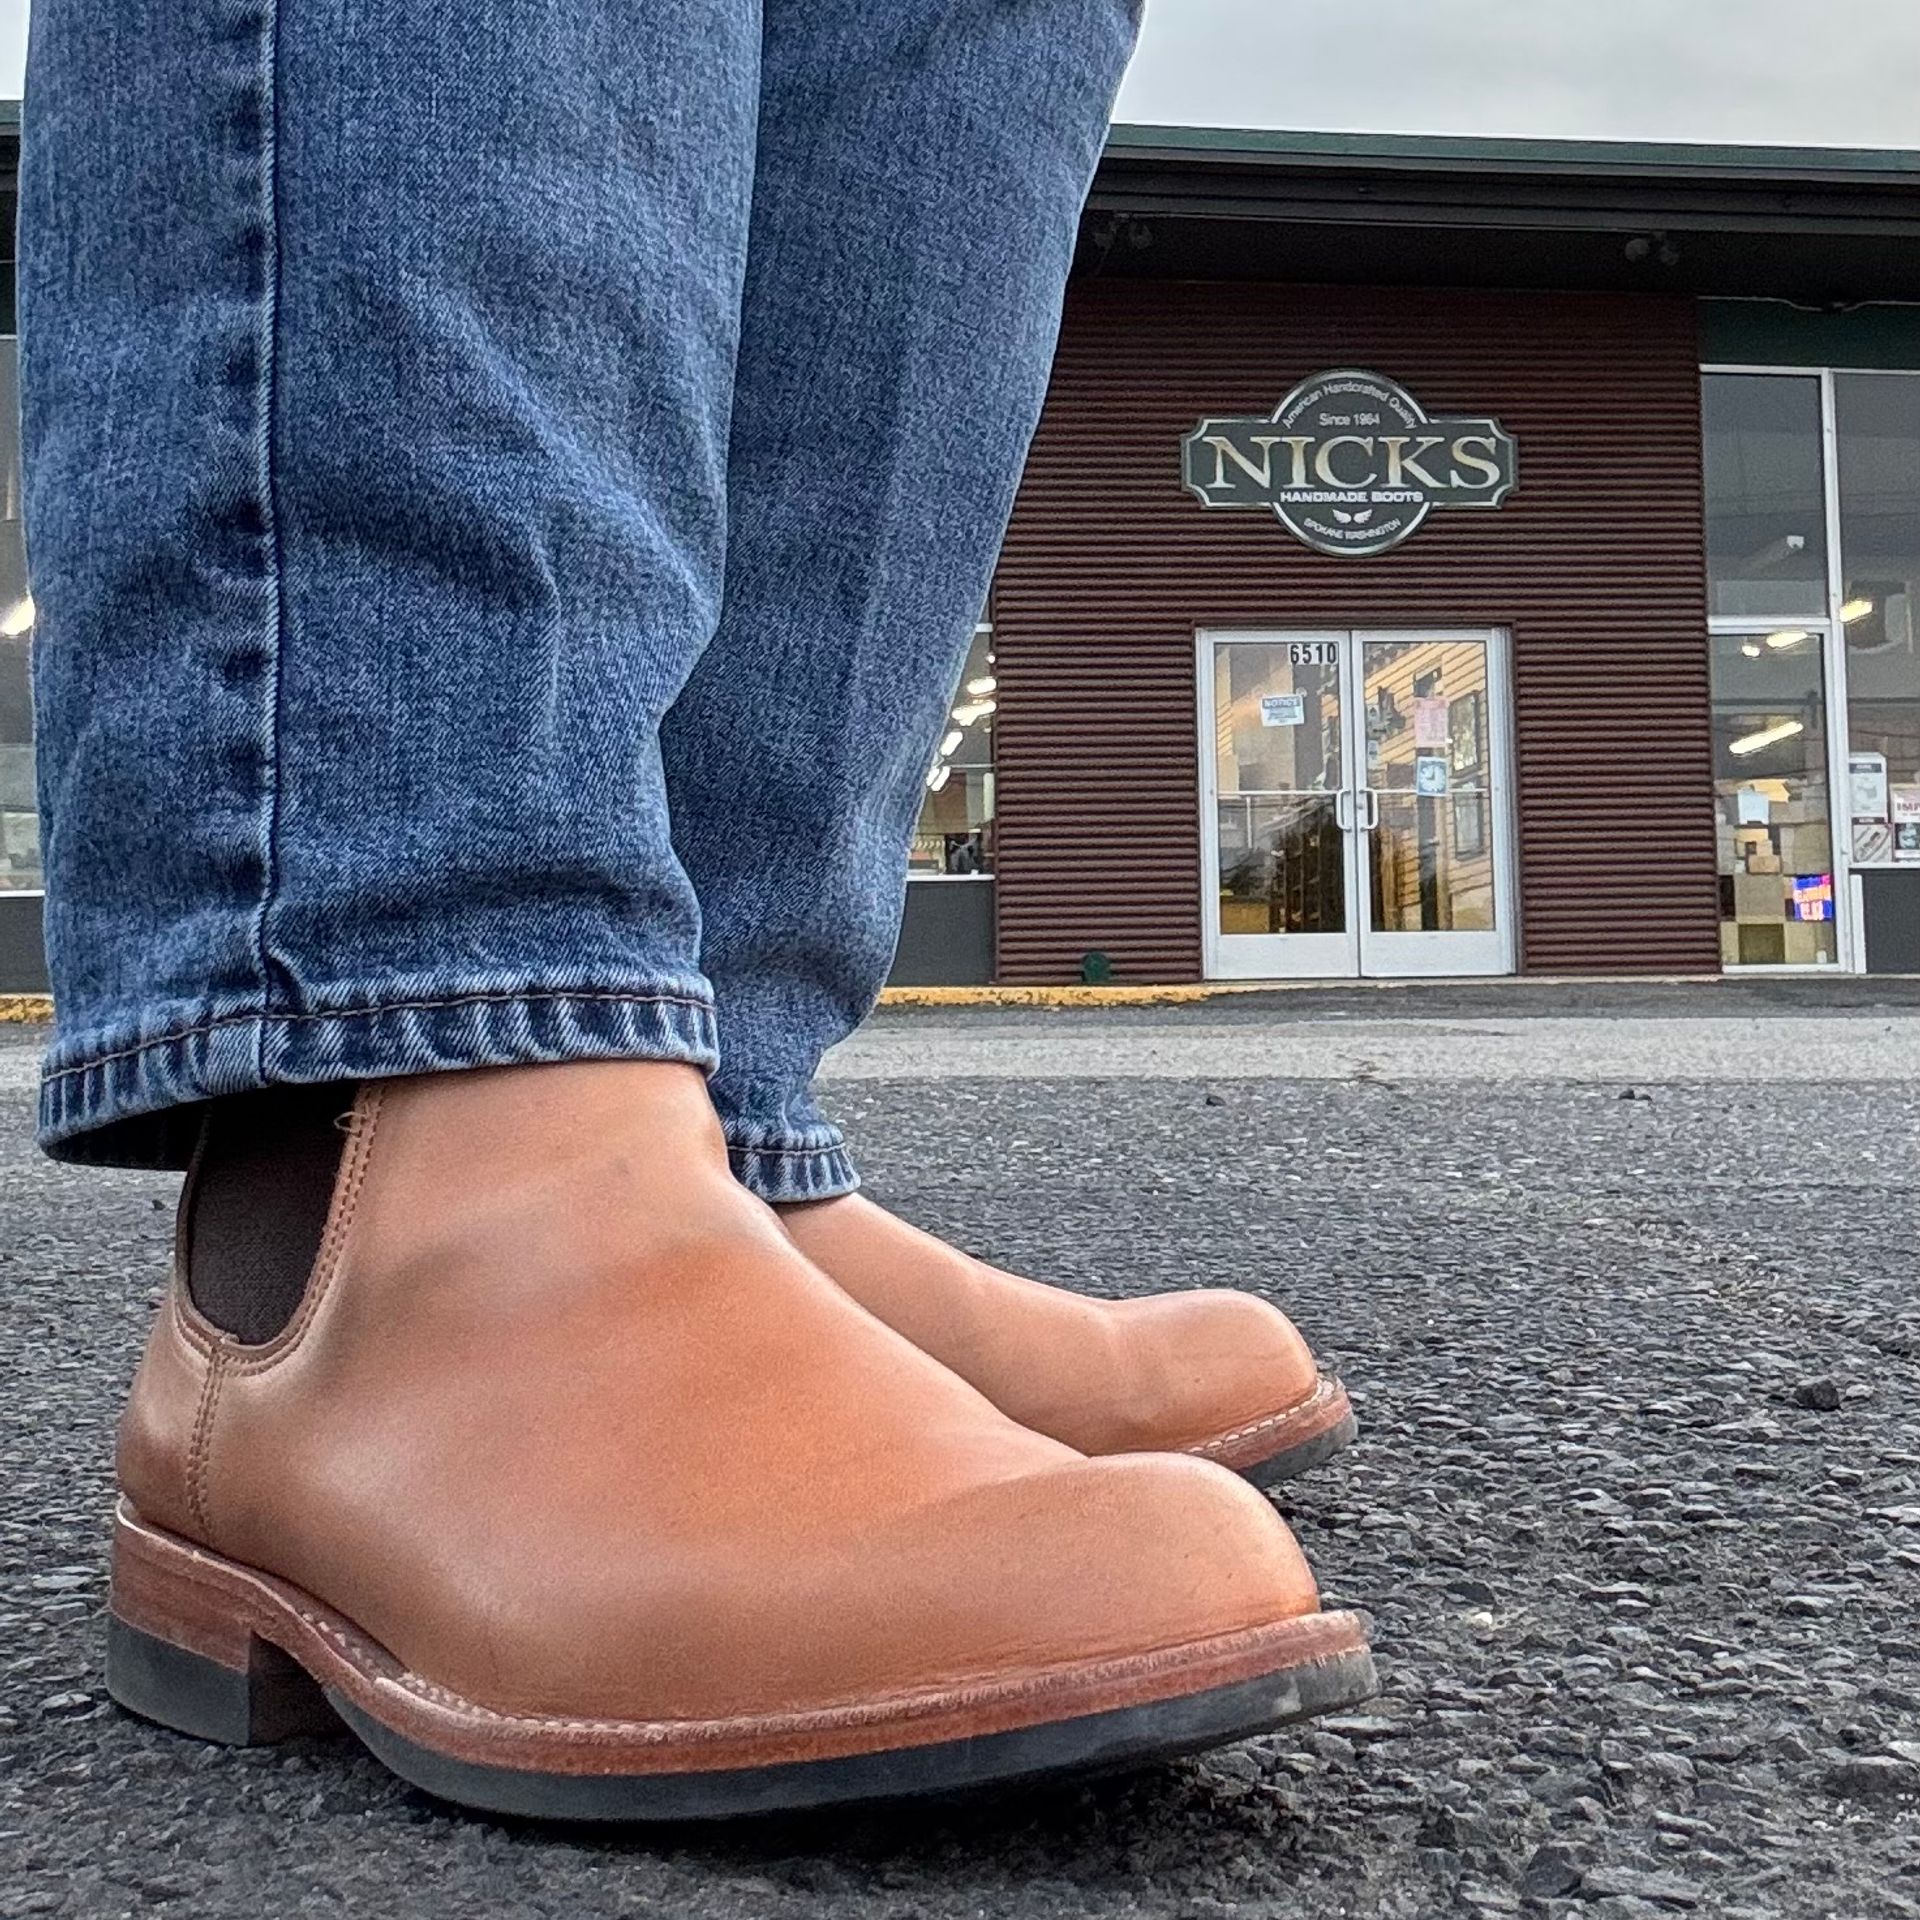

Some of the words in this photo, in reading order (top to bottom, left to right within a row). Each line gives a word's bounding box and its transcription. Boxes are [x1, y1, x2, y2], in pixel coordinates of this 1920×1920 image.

[1282, 390, 1323, 430] American
[1322, 381, 1391, 403] Handcrafted
[1389, 397, 1418, 430] Quality
[1319, 413, 1350, 426] Since
[1202, 436, 1501, 489] NICKS
[1280, 491, 1368, 503] HANDMADE
[1371, 491, 1424, 503] BOOTS
[1303, 517, 1344, 540] SPOKANE
[1290, 643, 1336, 664] 6510
